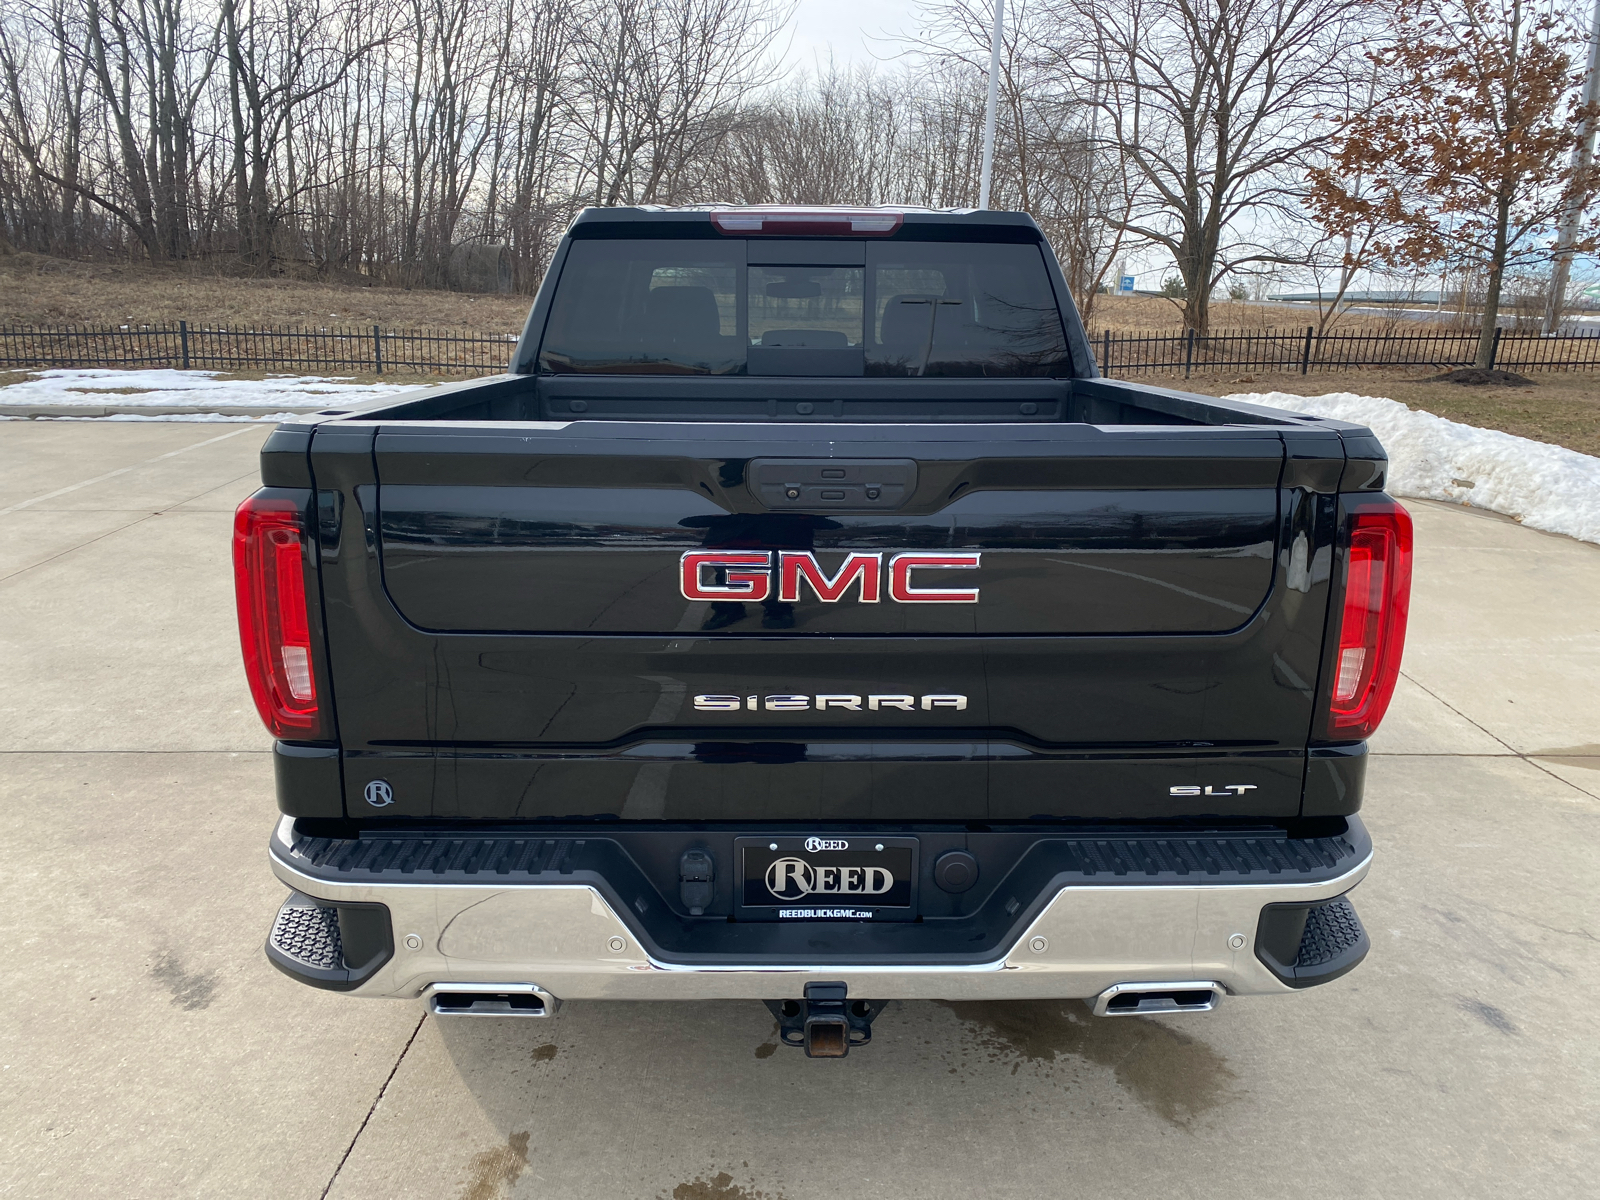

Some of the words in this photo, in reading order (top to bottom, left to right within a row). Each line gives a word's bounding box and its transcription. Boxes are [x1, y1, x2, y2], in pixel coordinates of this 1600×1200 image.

[679, 550, 981, 603] GMC
[693, 695, 968, 711] SIERRA
[1169, 784, 1258, 796] SLT
[804, 836, 849, 853] REED
[765, 856, 894, 901] REED
